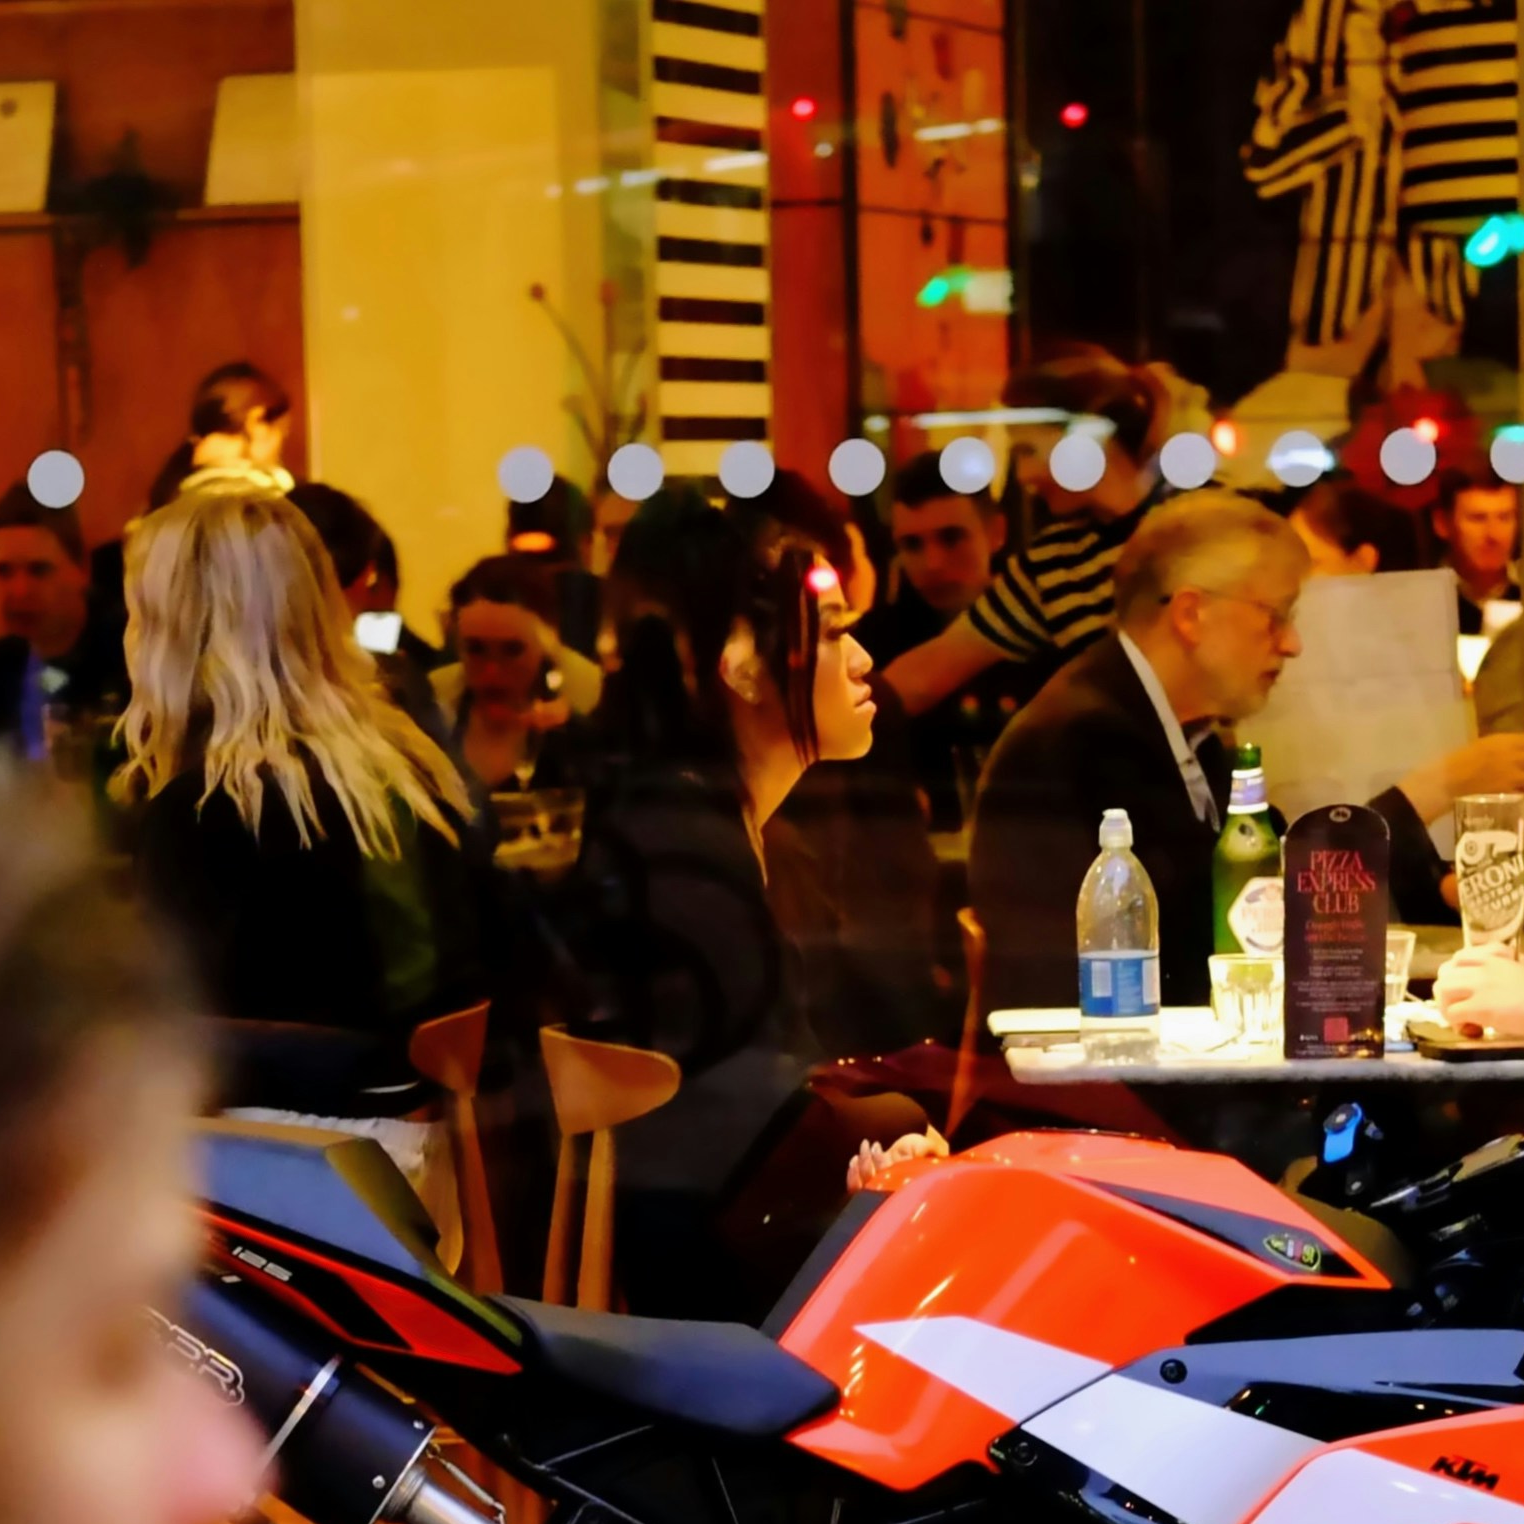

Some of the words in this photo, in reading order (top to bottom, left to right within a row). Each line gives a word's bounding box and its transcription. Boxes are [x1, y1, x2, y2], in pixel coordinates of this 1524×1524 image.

[1310, 850, 1364, 871] PIZZA
[1297, 871, 1376, 892] EXPRESS
[1462, 853, 1524, 897] ERONI
[1313, 893, 1360, 914] CLUB
[232, 1246, 293, 1282] 125
[1429, 1453, 1501, 1492] KTM
